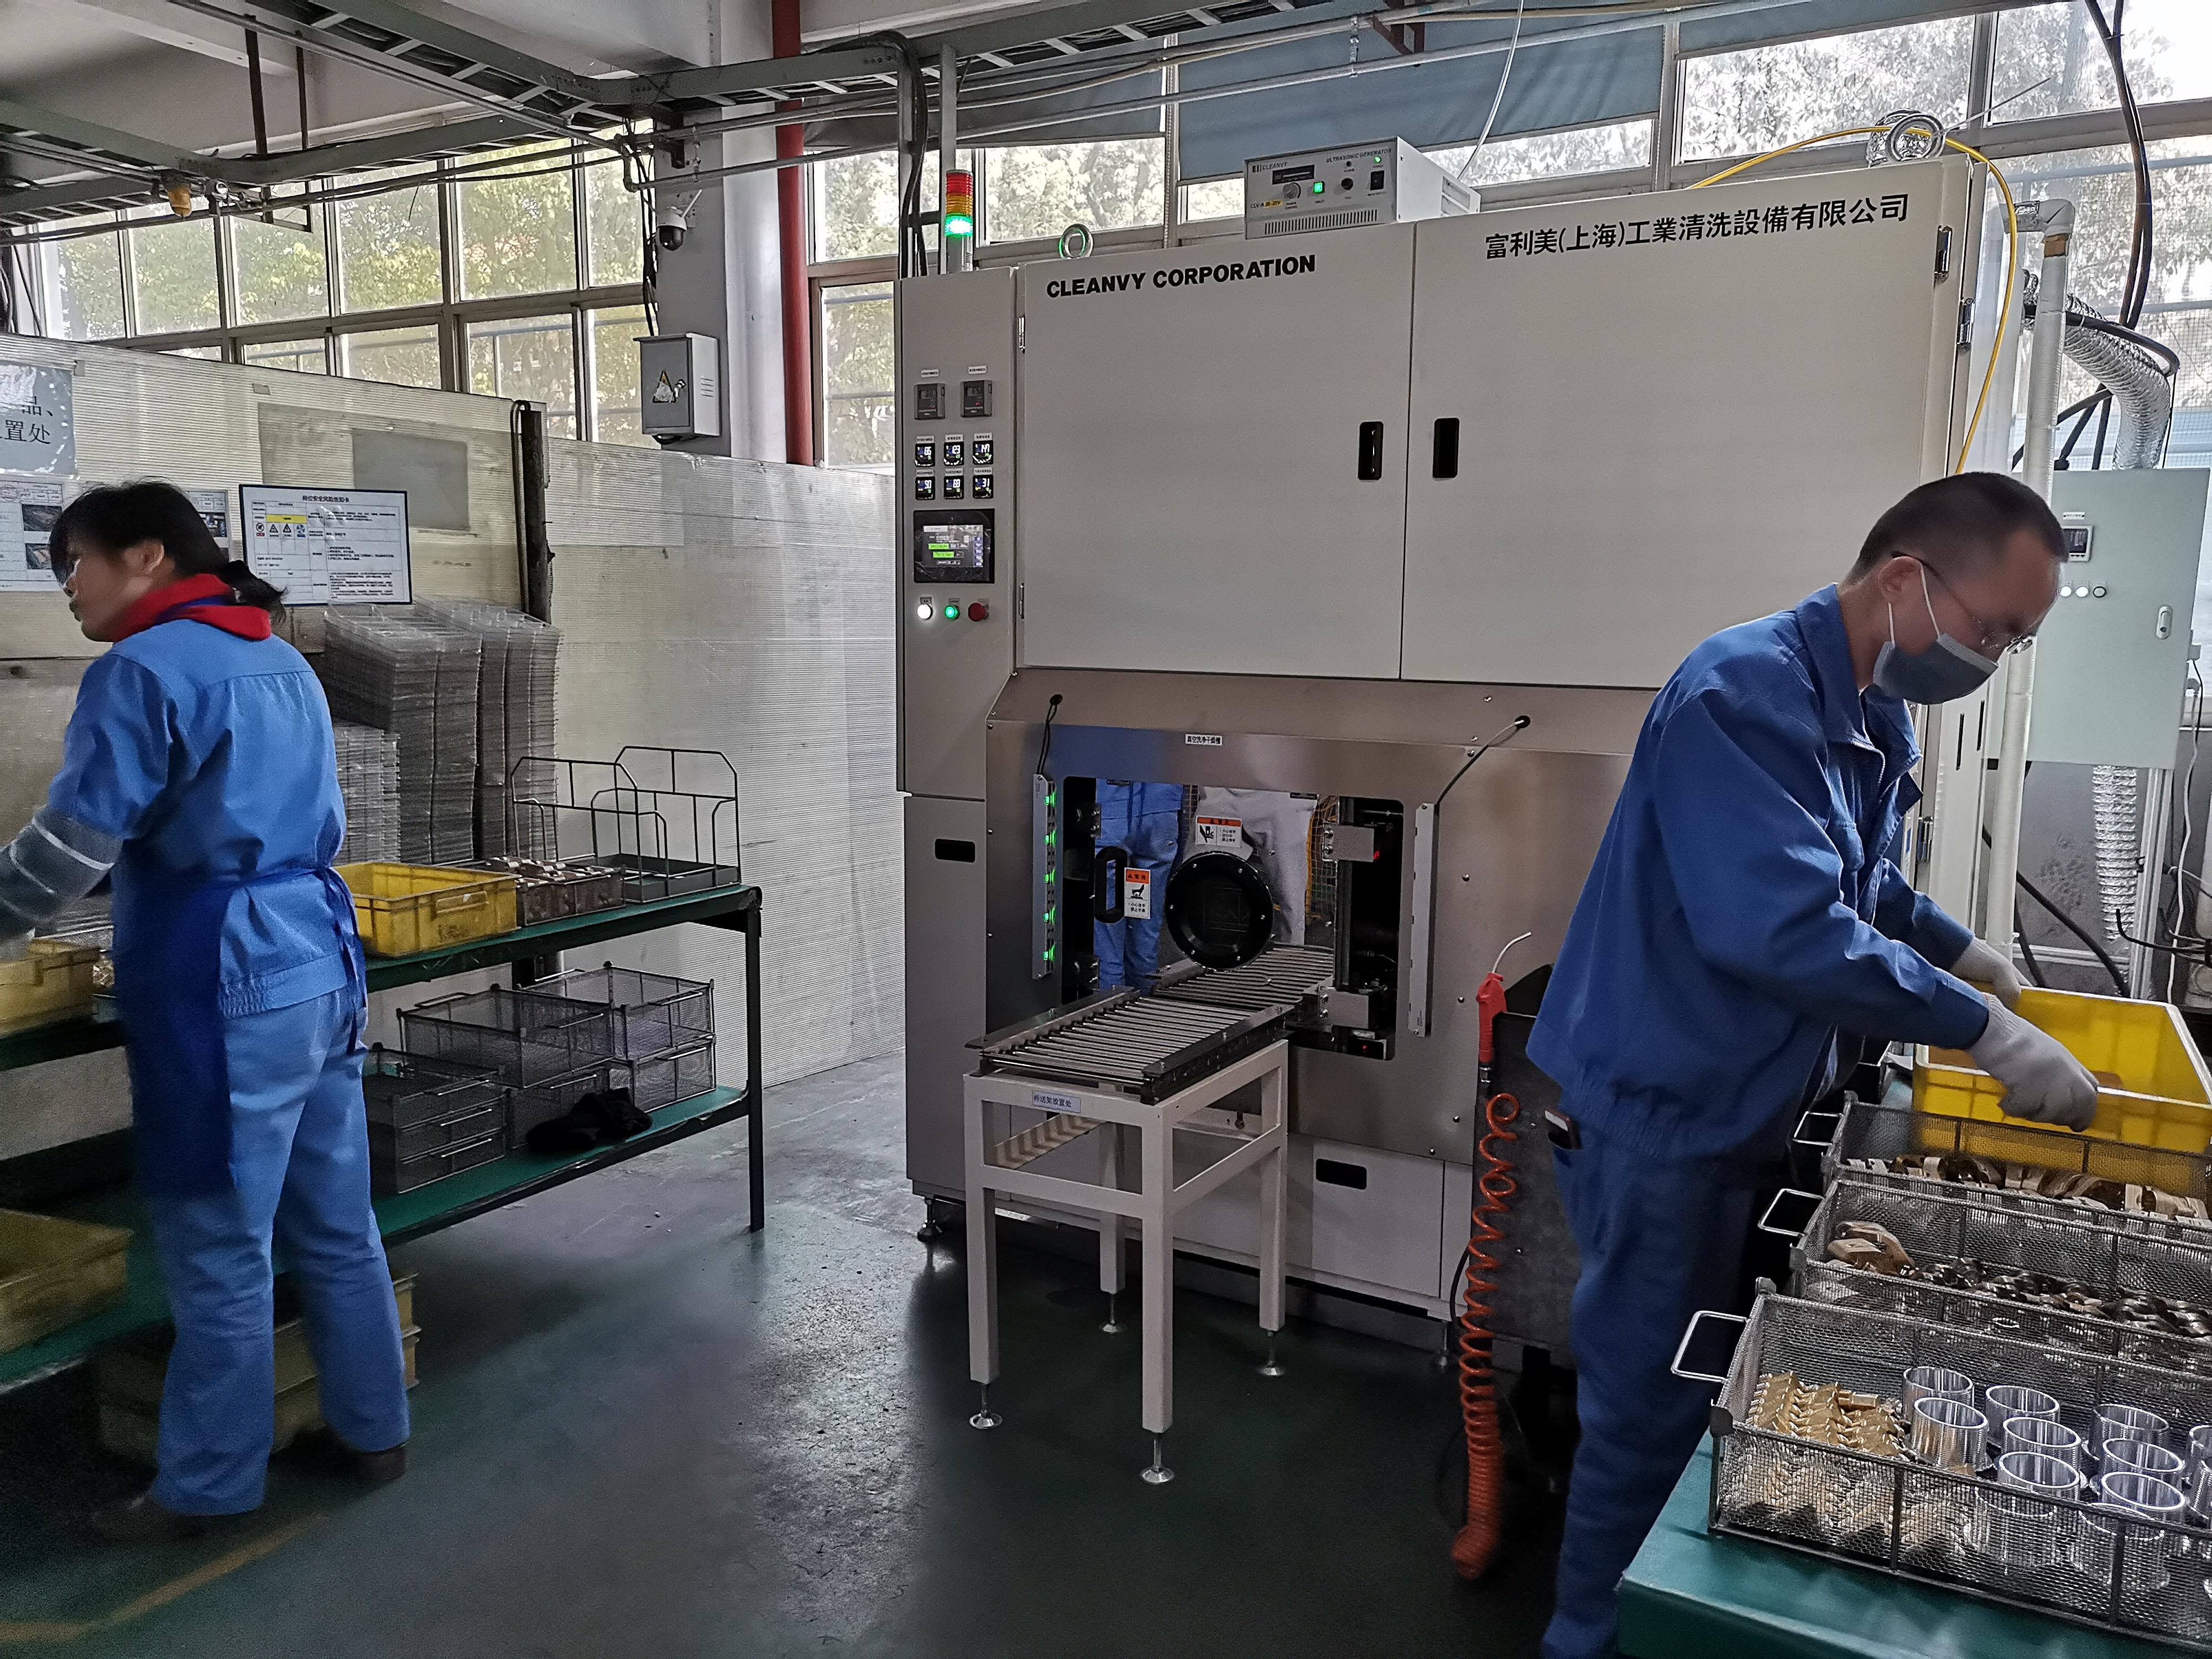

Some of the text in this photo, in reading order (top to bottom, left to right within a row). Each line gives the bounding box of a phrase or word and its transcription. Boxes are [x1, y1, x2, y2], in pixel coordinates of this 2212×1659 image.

[1485, 194, 1910, 260] 富利美(上海)工業清洗設備有限公司
[1046, 254, 1316, 298] CLEANVY CORPORATION
[0, 419, 51, 444] 置处
